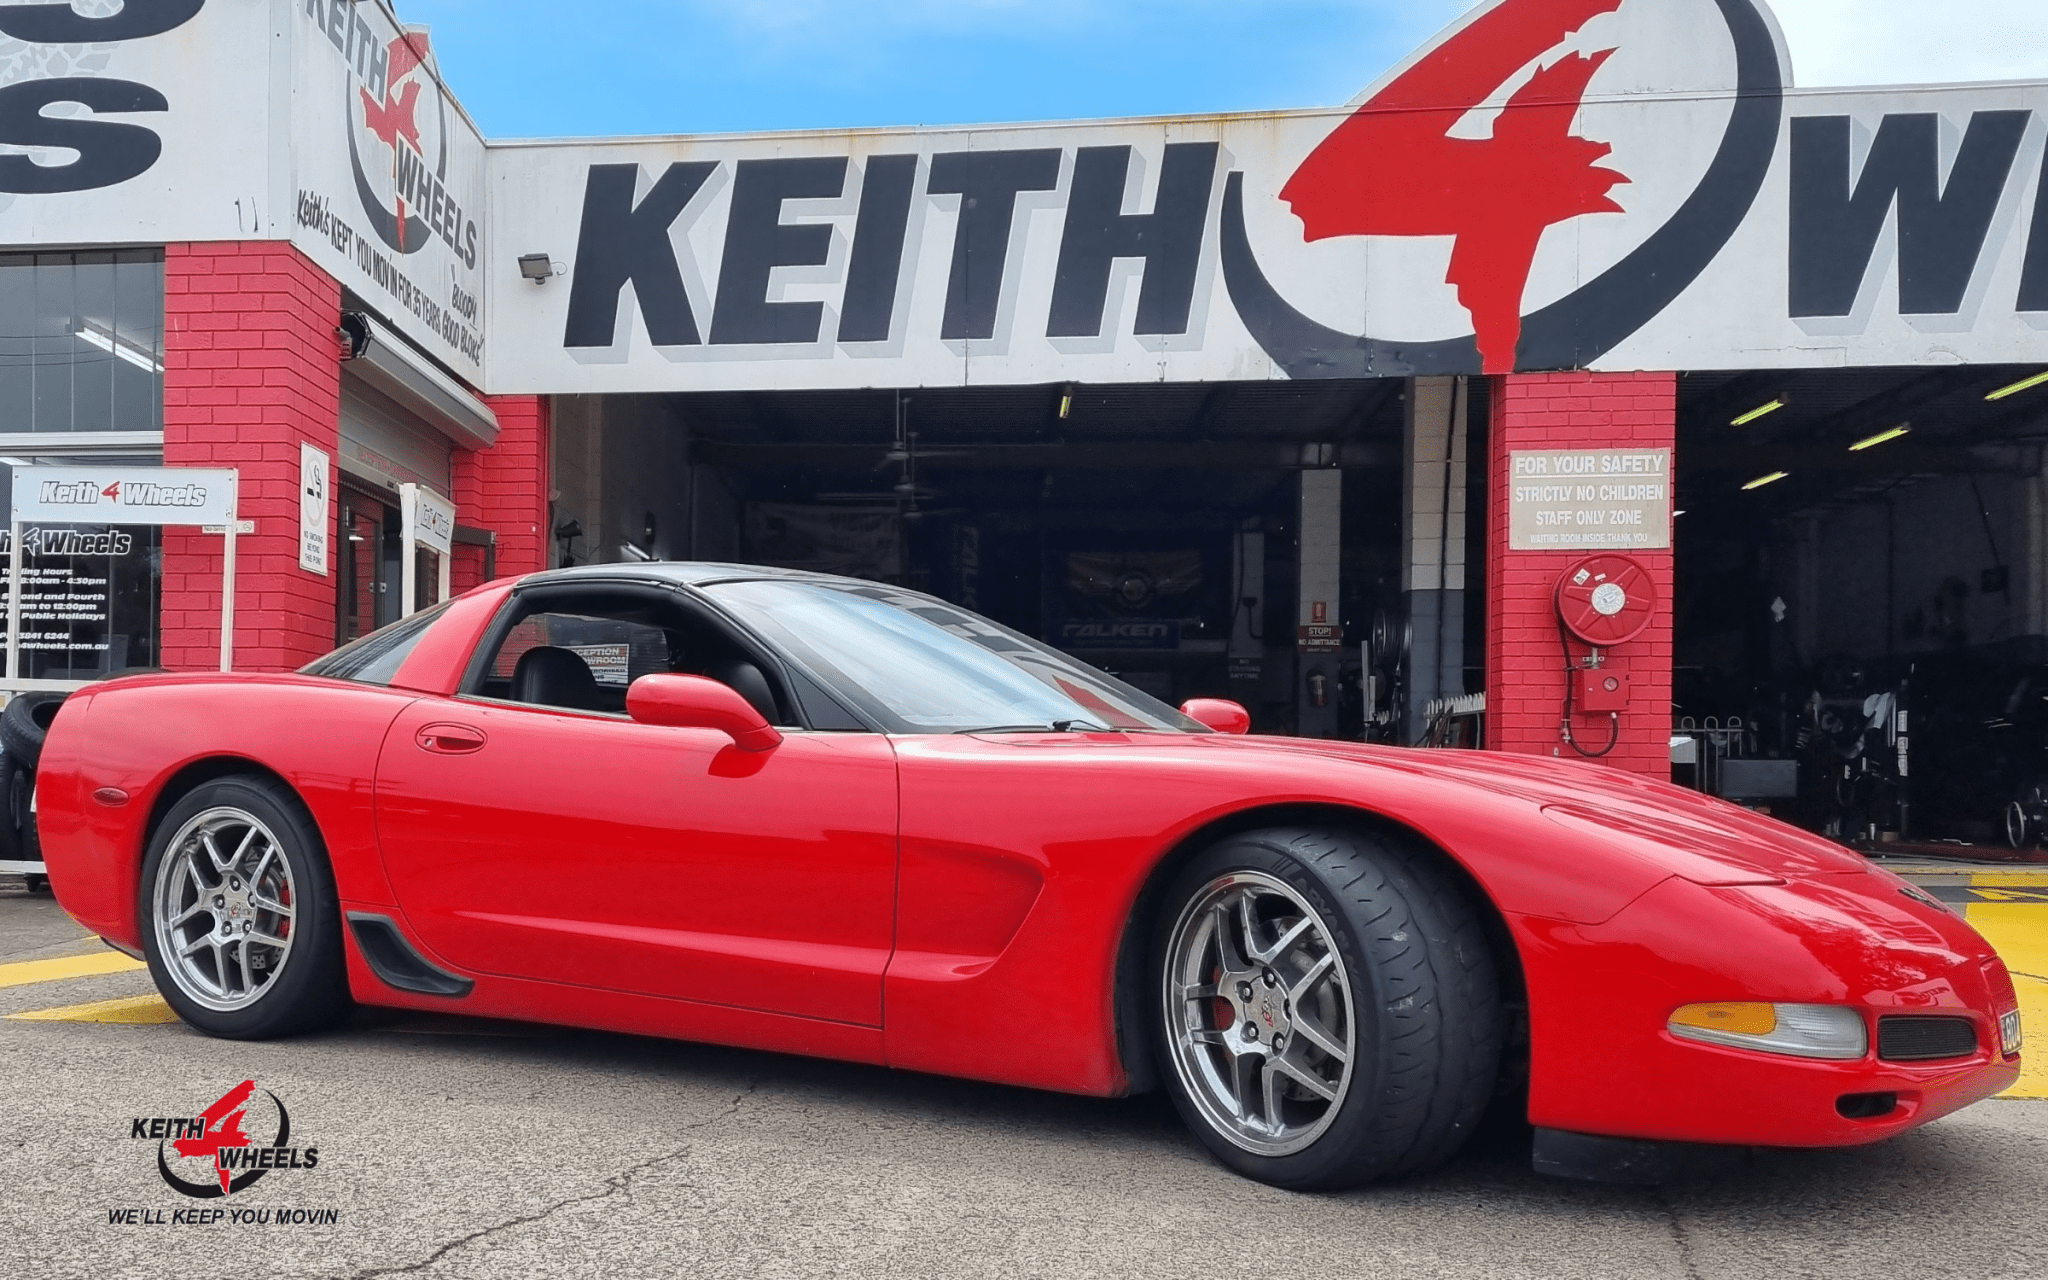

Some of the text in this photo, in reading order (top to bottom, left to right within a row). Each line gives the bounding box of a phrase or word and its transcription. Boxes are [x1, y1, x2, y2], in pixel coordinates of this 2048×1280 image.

[563, 141, 1220, 348] KEITH
[1278, 0, 1632, 374] 4
[396, 137, 477, 270] WHEELS
[331, 213, 352, 260] KEPT
[355, 230, 372, 276] YOU
[399, 273, 412, 312] FOR
[413, 286, 421, 318] 35
[421, 292, 441, 335] YEARS
[442, 309, 460, 349] GOOD
[1515, 454, 1664, 474] FOR YOUR SAFETY
[39, 481, 207, 507] Keith 4 Wheels
[1515, 484, 1664, 502] STRICTLY NO CHILDREN
[1535, 509, 1642, 526] STAFF ONLY ZONE
[42, 529, 131, 555] Wheels
[1530, 532, 1648, 543] WAITING ROOM INSIDE THANK YOU
[42, 568, 73, 576] Hours
[66, 577, 107, 586] 4:30pm
[53, 603, 97, 611] 12:00pm
[21, 612, 106, 621] Public Holidays
[44, 632, 70, 640] 6244
[1062, 624, 1169, 637] FALKEN
